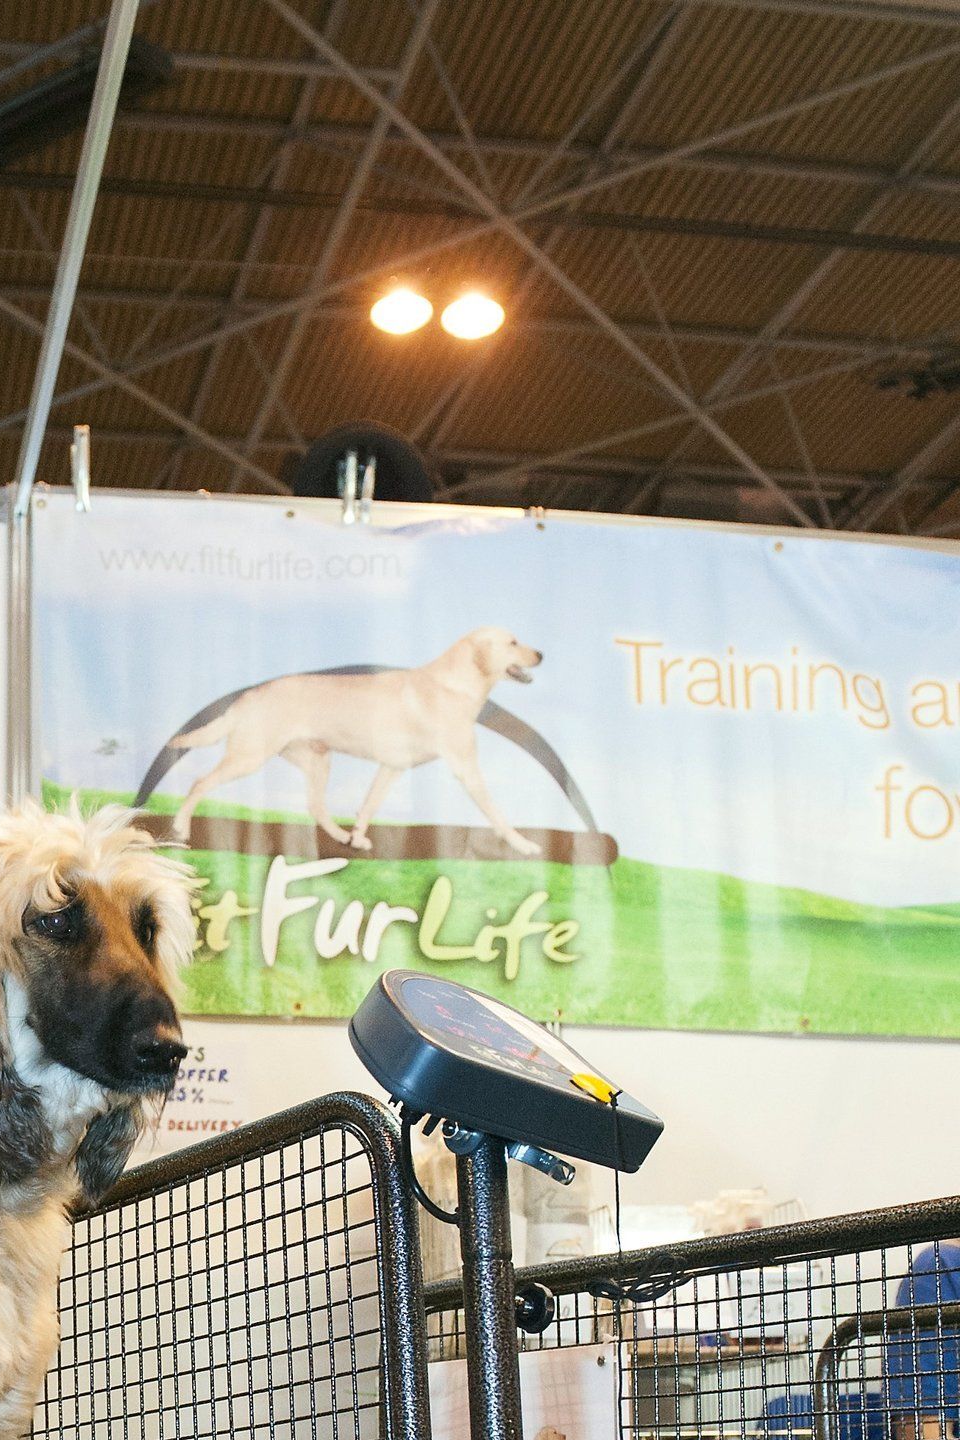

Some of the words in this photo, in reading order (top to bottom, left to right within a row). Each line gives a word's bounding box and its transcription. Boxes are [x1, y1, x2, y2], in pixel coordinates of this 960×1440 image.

[98, 545, 402, 581] www.fitfurlife.com
[614, 637, 891, 730] Training
[911, 679, 960, 729] a
[875, 764, 960, 841] fo
